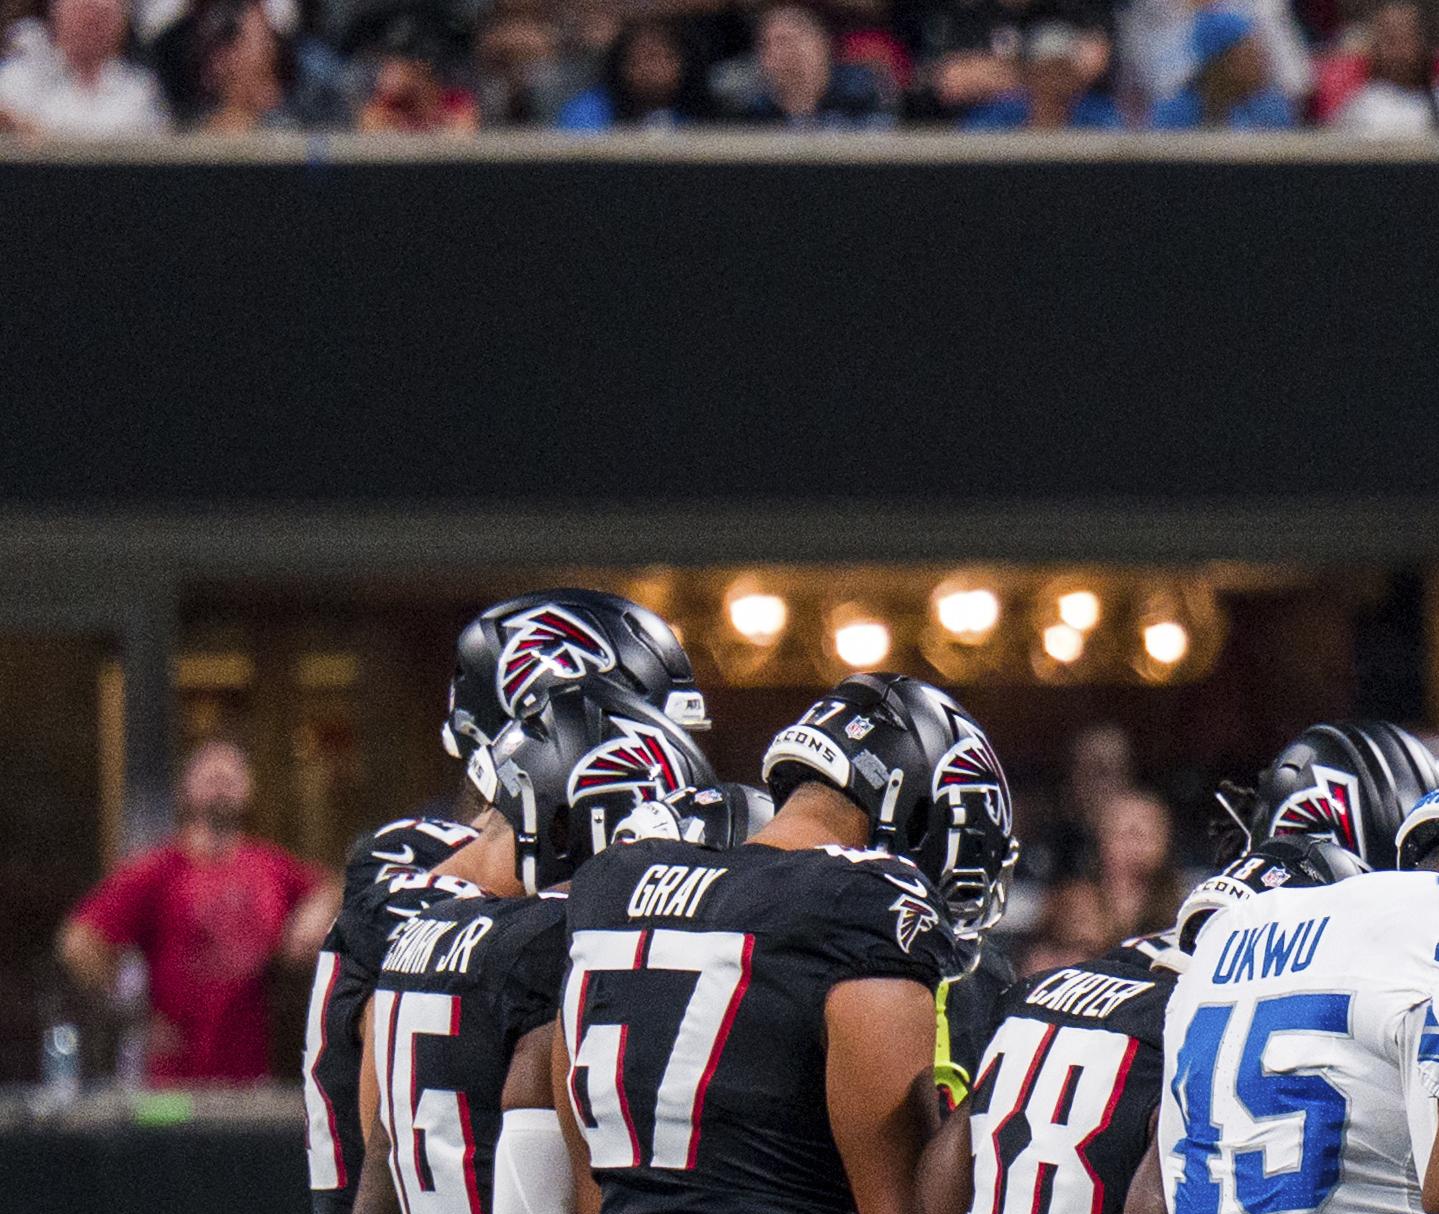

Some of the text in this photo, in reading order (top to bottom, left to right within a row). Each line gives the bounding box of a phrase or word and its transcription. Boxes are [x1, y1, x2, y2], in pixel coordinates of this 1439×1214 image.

[627, 864, 730, 919] GRAY
[1025, 968, 1157, 1019] CARTER
[563, 929, 757, 1171] 67
